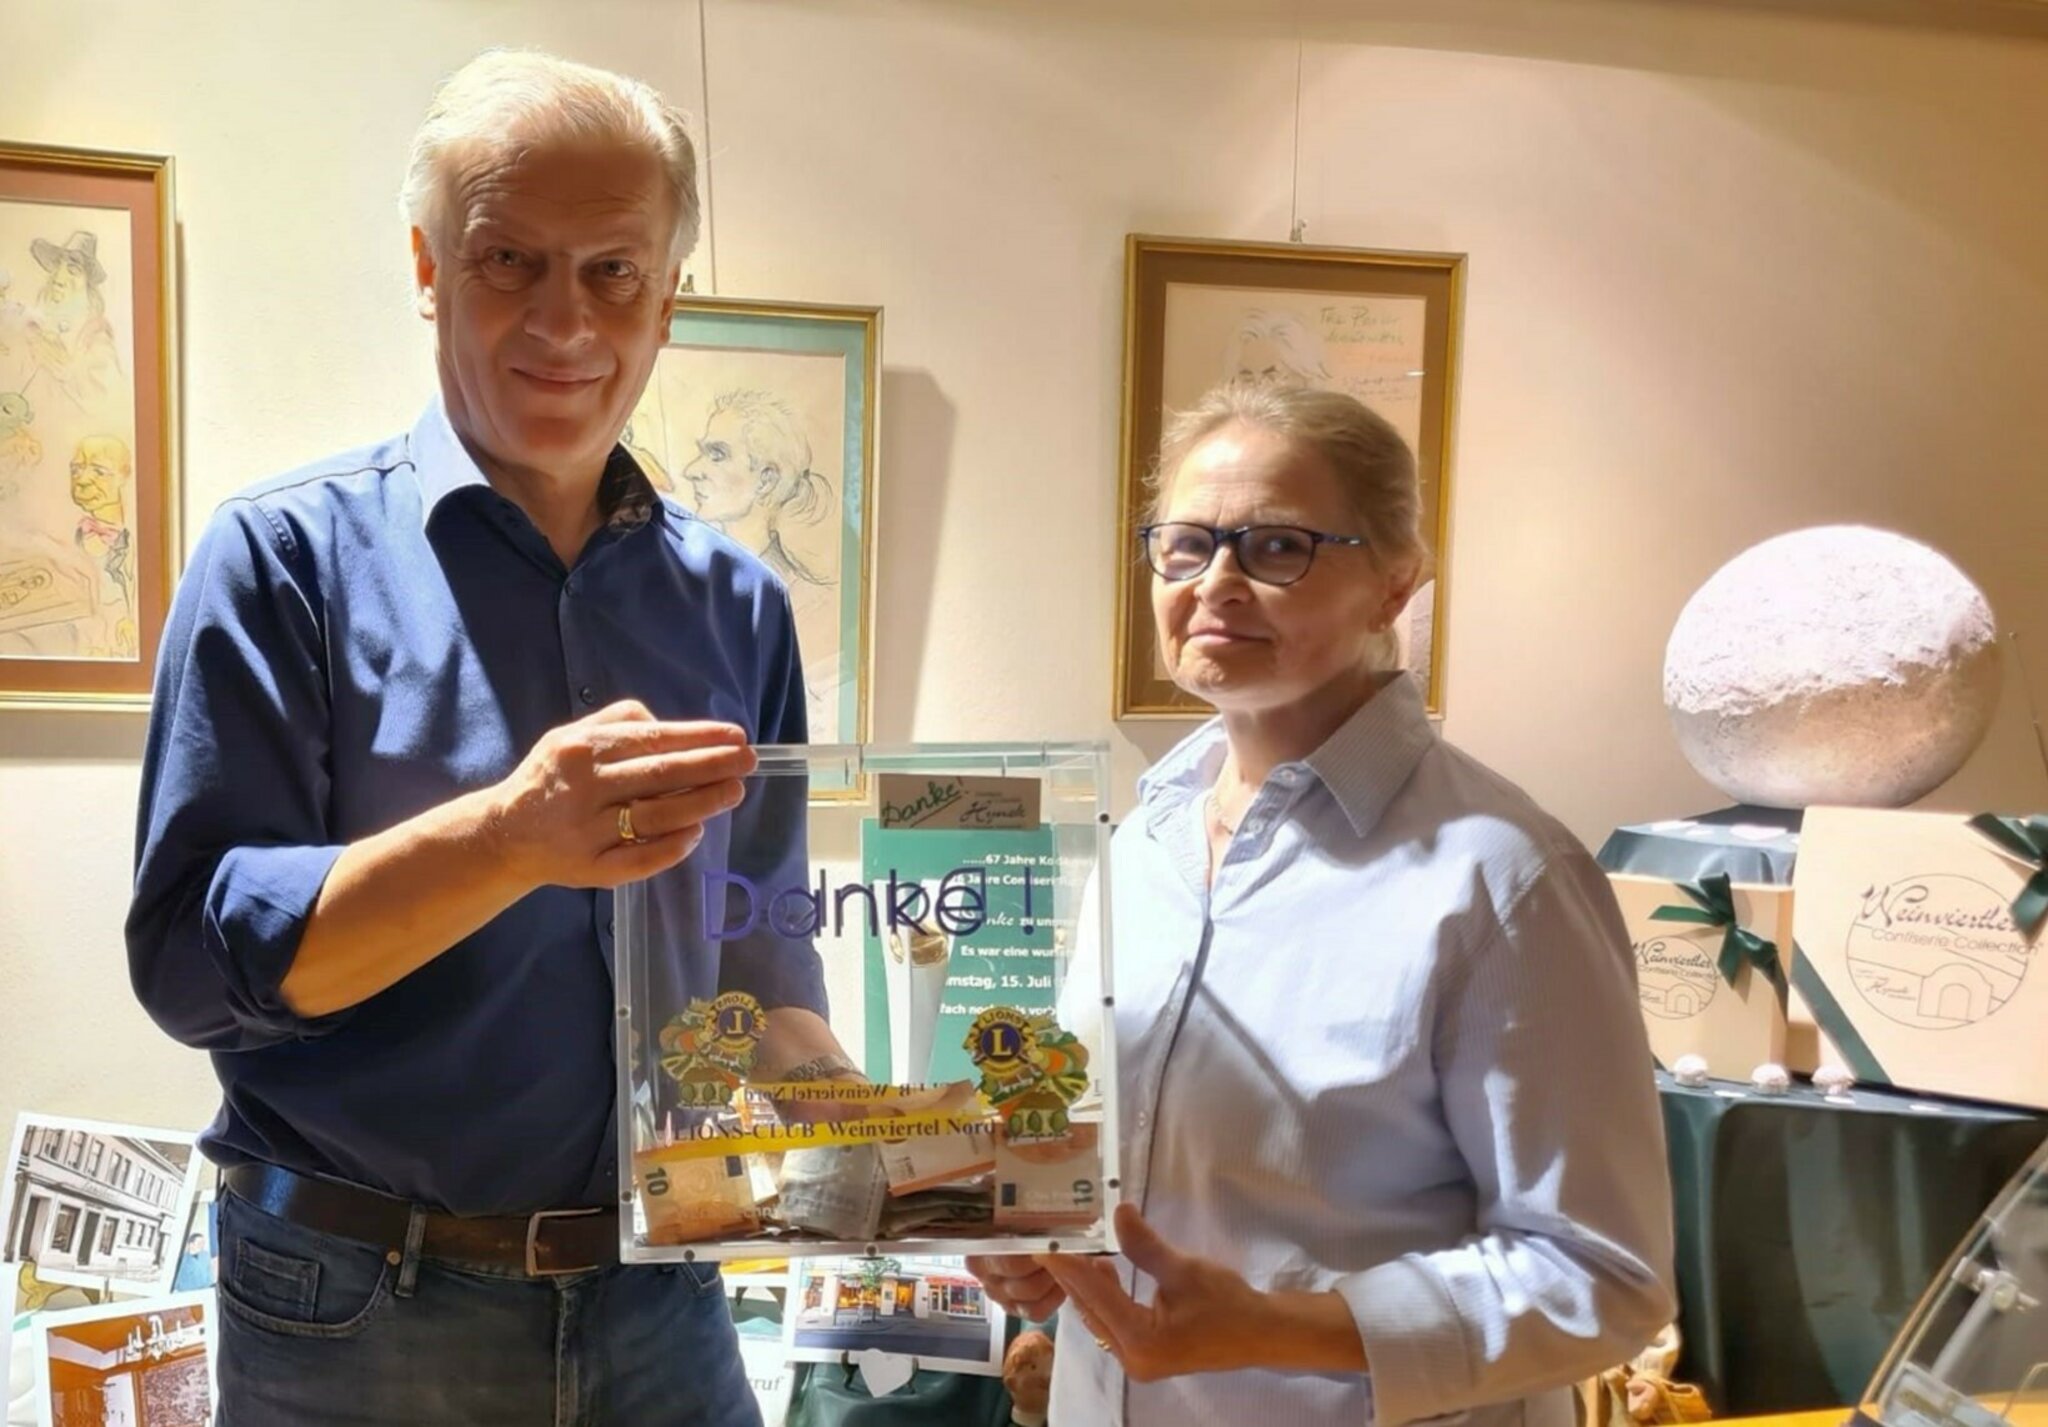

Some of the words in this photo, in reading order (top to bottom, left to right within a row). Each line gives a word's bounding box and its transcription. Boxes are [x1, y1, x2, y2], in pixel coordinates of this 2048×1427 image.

[1003, 855, 1036, 866] Jahre
[968, 875, 1000, 885] Jare
[702, 868, 986, 940] Danke
[960, 945, 975, 957] Es
[978, 948, 1000, 957] war
[1003, 947, 1029, 957] eine
[1001, 976, 1023, 987] 15.
[1027, 975, 1051, 988] Juli
[982, 1010, 1022, 1025] LIONS
[991, 1029, 1012, 1056] L
[674, 1121, 815, 1141] LIONS-CLUB
[827, 1118, 940, 1137] Weinviertel
[947, 1117, 996, 1136] Nord
[645, 1167, 669, 1196] 10
[1072, 1179, 1094, 1206] 10
[754, 1375, 785, 1391] ruf
